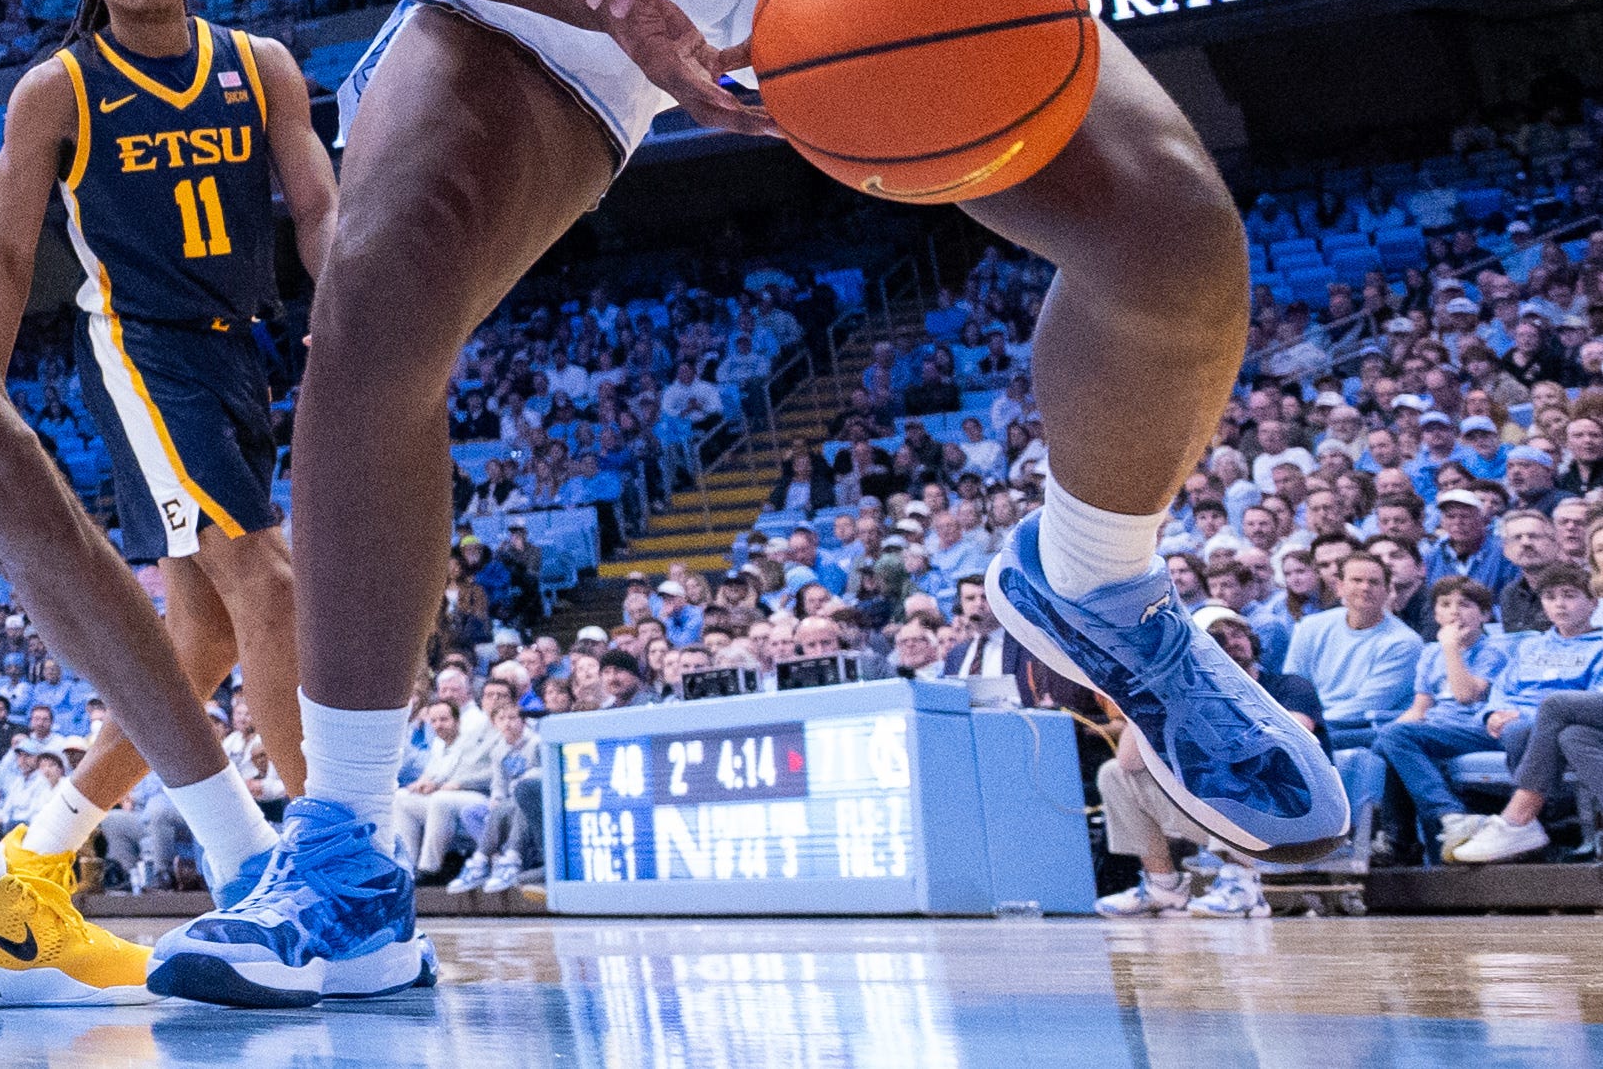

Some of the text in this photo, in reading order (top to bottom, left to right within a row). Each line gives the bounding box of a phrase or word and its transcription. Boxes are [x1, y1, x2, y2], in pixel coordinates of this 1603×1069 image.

[116, 125, 251, 173] ETSU
[174, 175, 232, 259] 11
[716, 736, 776, 790] 4:14
